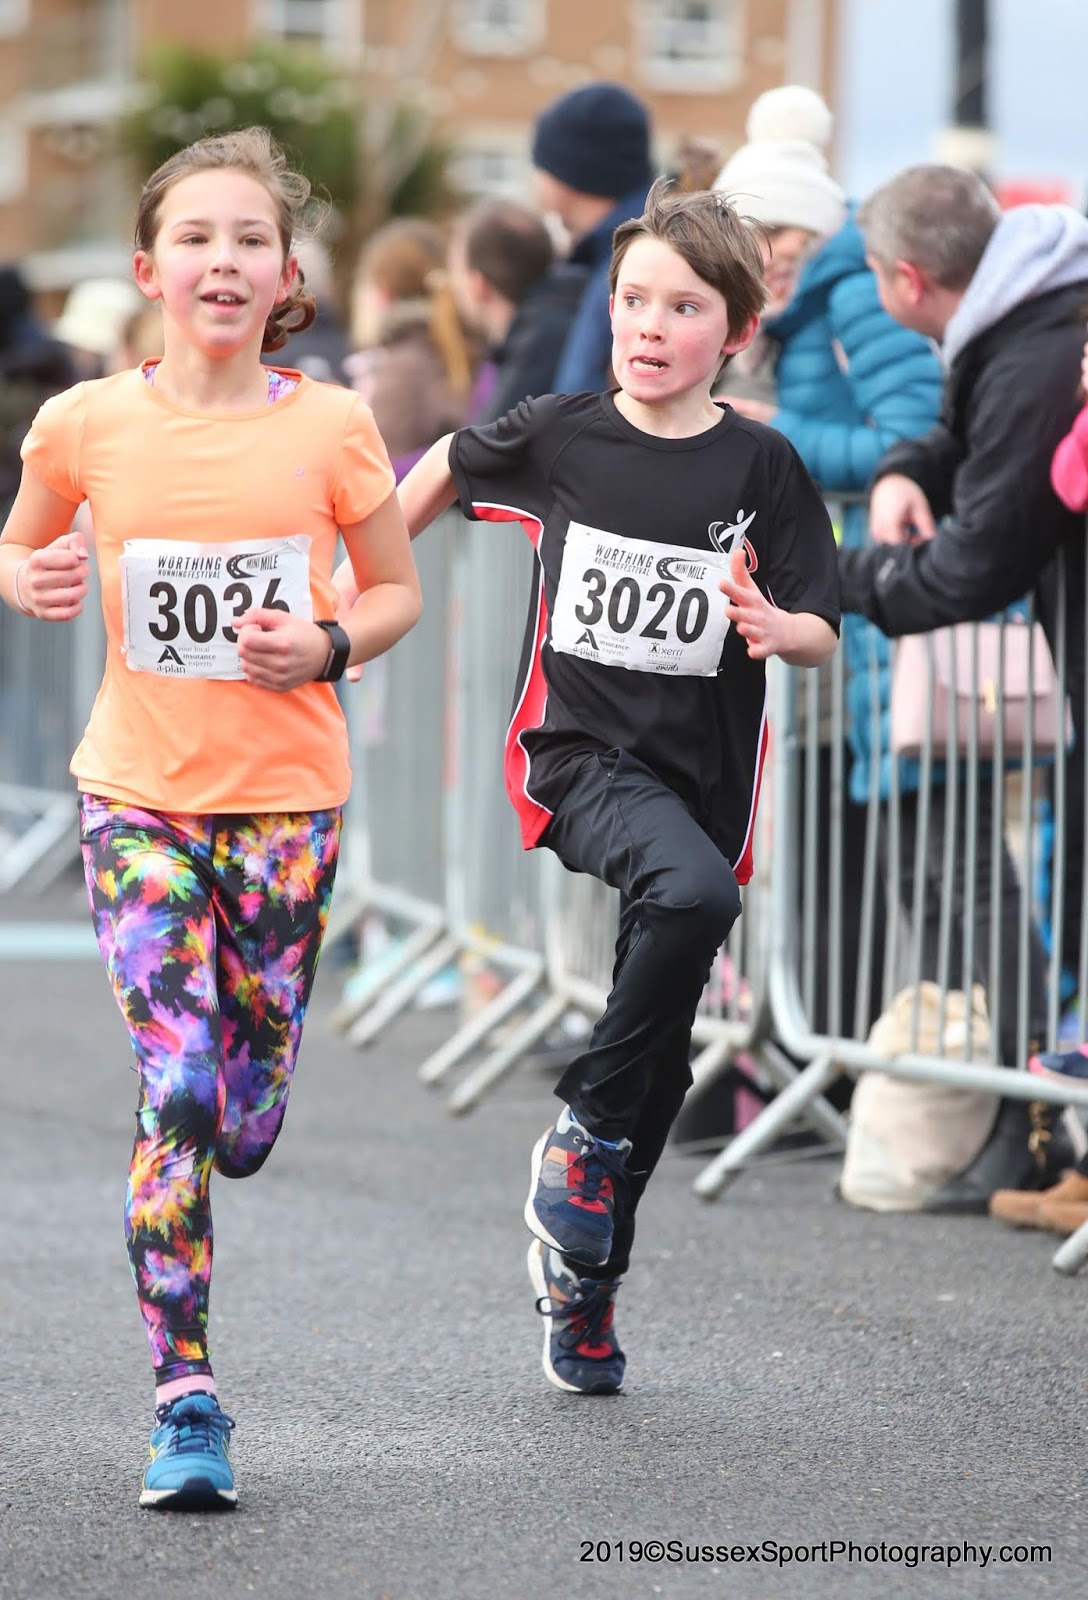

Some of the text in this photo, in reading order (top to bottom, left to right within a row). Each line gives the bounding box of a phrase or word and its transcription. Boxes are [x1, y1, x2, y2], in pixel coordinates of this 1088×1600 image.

[158, 555, 222, 571] WORTHING
[246, 555, 279, 571] MINI MILE
[595, 544, 654, 568] WORTHING
[674, 563, 707, 580] MINI MILE
[575, 568, 709, 643] 3020
[661, 648, 684, 656] xerri
[157, 664, 186, 674] a-plan
